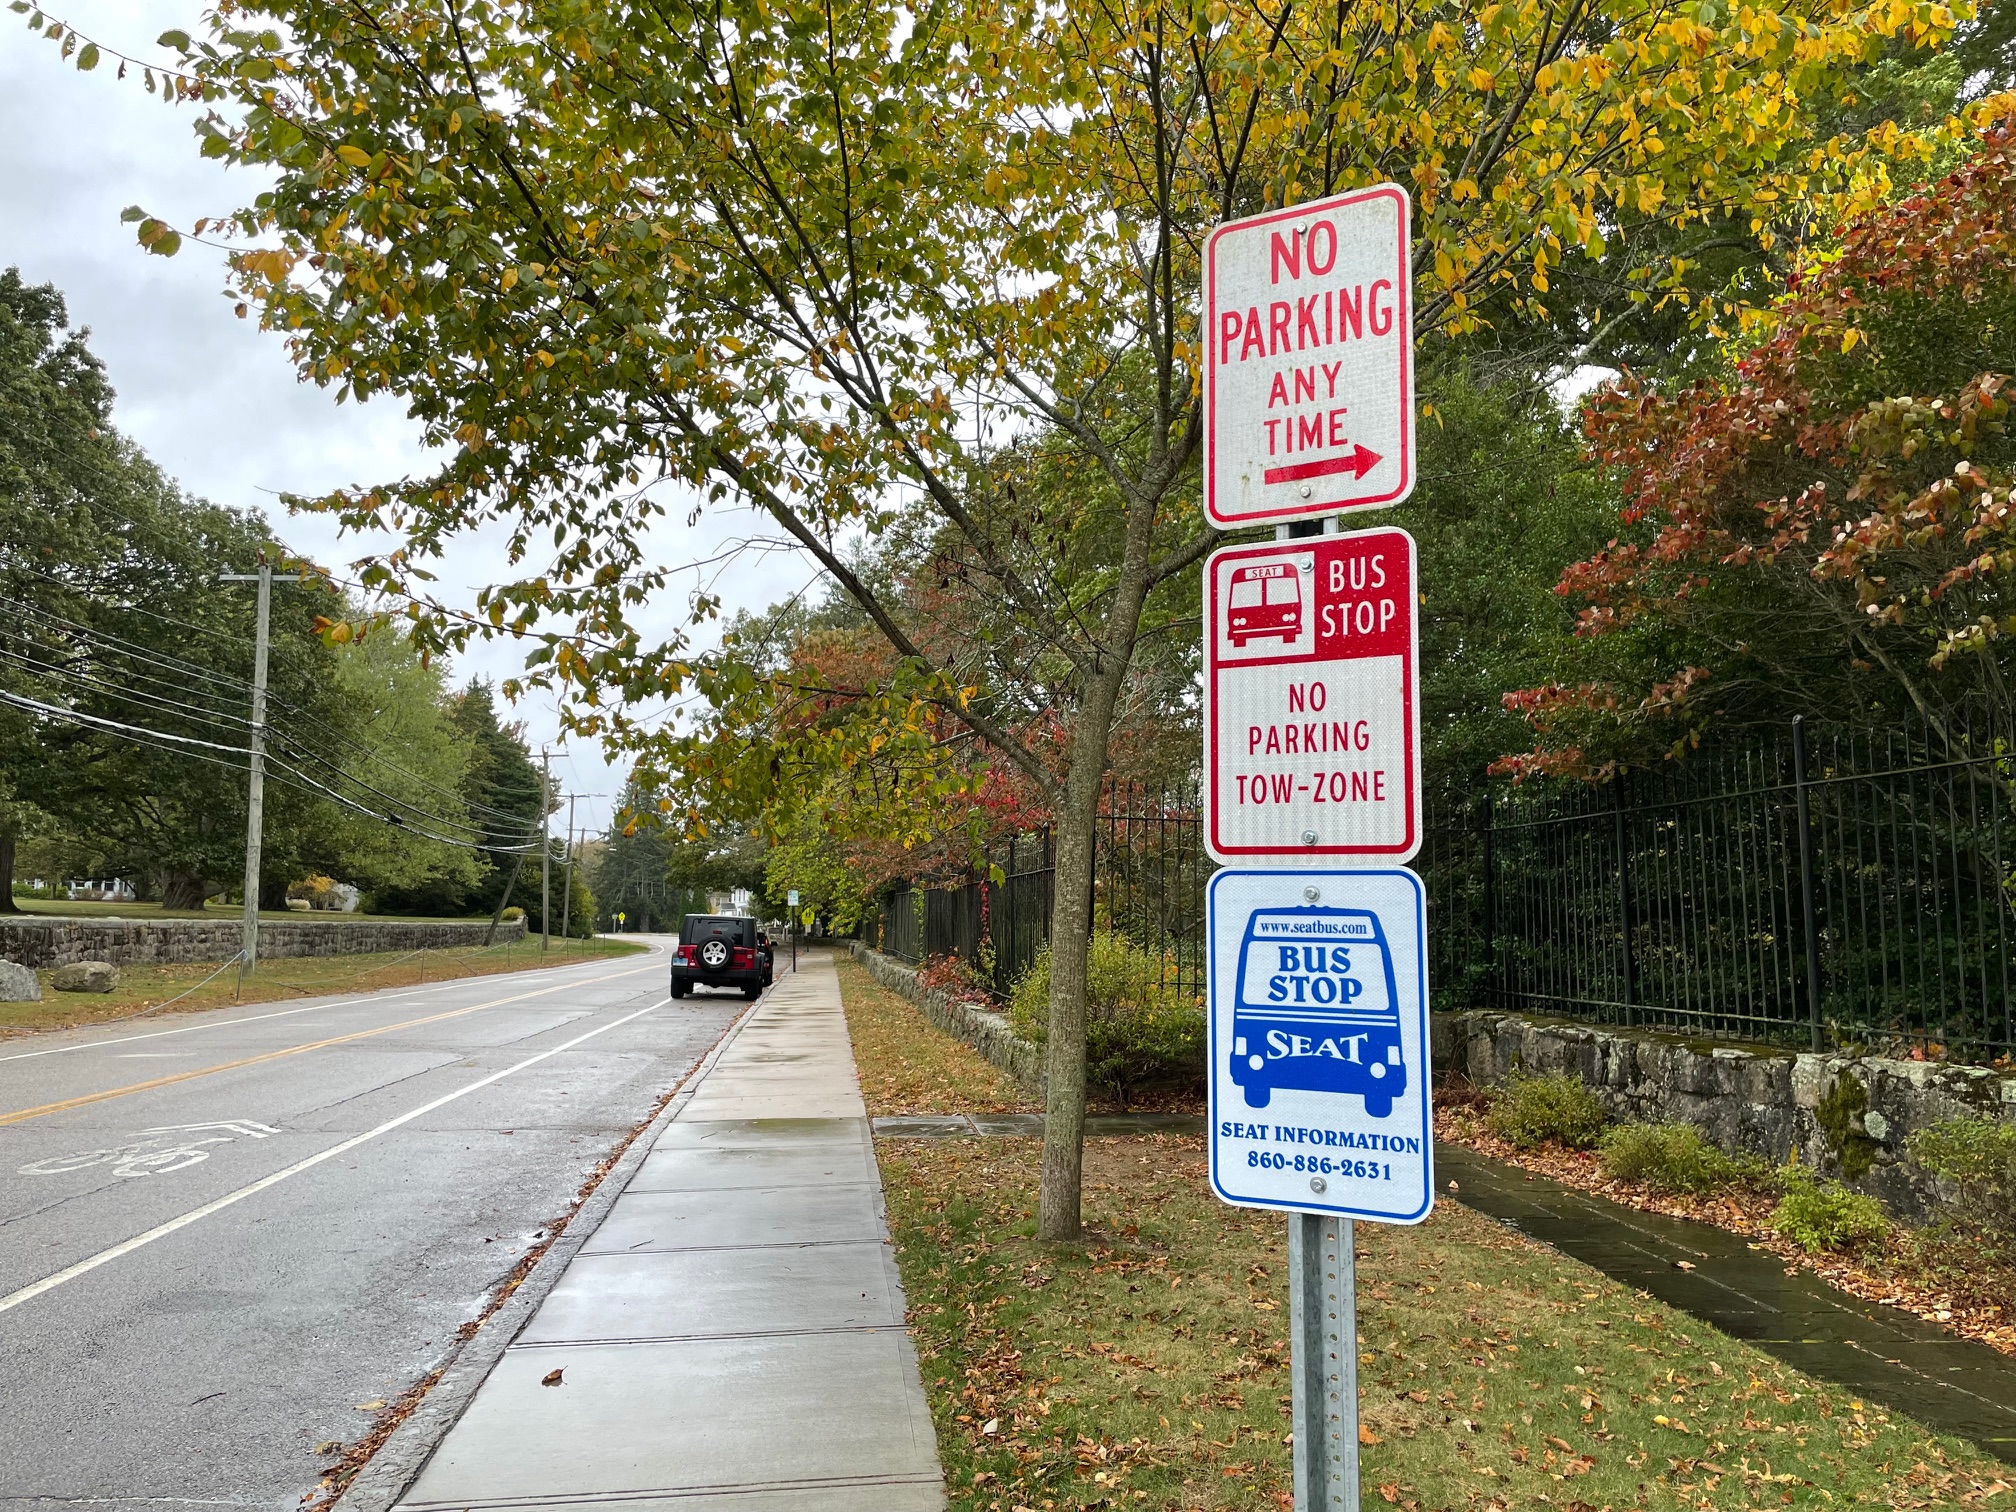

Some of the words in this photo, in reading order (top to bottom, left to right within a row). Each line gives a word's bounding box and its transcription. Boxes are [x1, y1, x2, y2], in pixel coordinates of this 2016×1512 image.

[1271, 220, 1337, 284] NO
[1221, 279, 1392, 364] PARKING
[1268, 361, 1342, 408] ANY
[1264, 408, 1348, 455] TIME
[1252, 567, 1277, 578] SEAT
[1329, 555, 1385, 593] BUS
[1321, 599, 1395, 637] STOP
[1289, 681, 1326, 713] NO
[1249, 720, 1369, 755] PARKING
[1236, 771, 1385, 804] TOW-ZONE
[1260, 920, 1367, 935] www.seatbus.com
[1278, 946, 1350, 974] BUS
[1268, 975, 1363, 1004] STOP
[1266, 1029, 1368, 1064] SEAT
[1221, 1122, 1269, 1140] SEAT
[1275, 1126, 1420, 1154] INFORMATION
[1247, 1150, 1391, 1180] 860-886-2631
